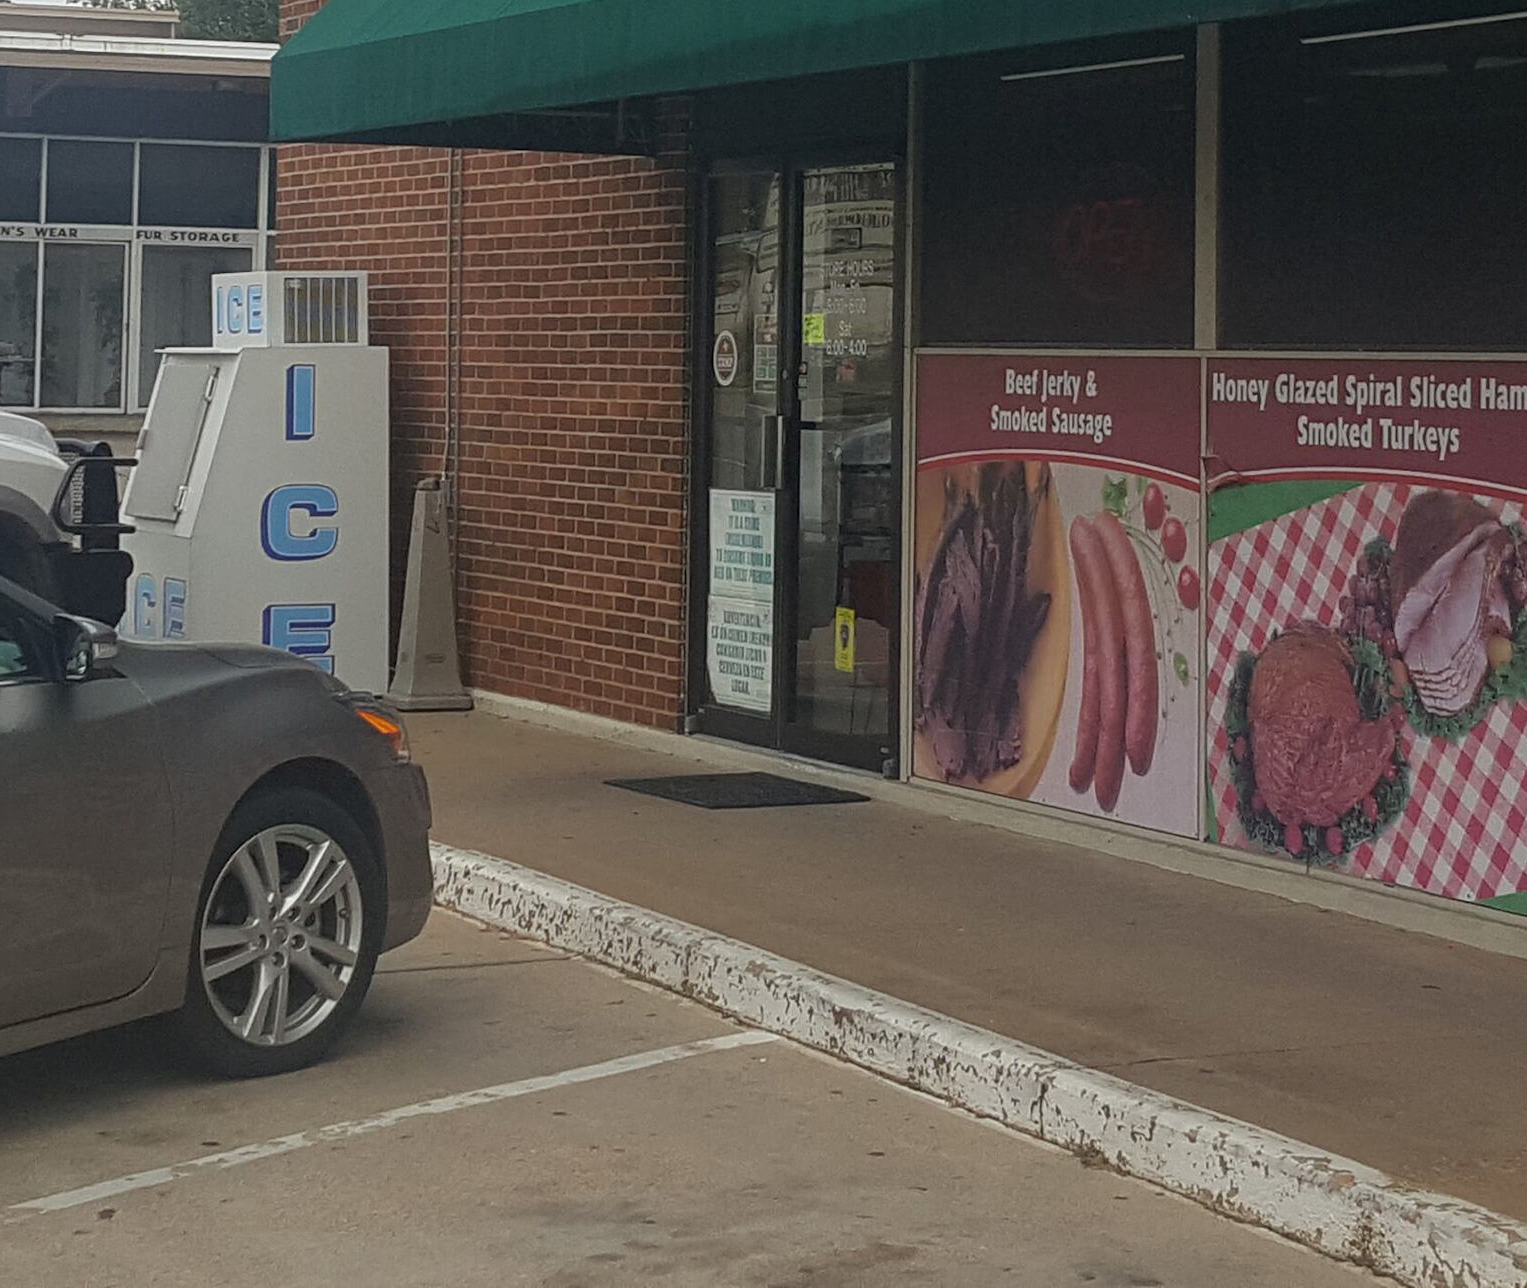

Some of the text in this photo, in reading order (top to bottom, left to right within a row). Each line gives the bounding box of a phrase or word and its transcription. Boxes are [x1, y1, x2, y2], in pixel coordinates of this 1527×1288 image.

[35, 227, 78, 238] WEAR
[136, 230, 240, 243] FUR STORAGE
[217, 284, 263, 334] ICE
[1005, 369, 1098, 404] Beef Jerky &
[1212, 373, 1269, 411] Honey
[1274, 373, 1339, 406] Glazed
[1345, 374, 1403, 415] Spiral
[1409, 375, 1471, 409] Sliced
[990, 405, 1113, 444] Smoked Sausage
[1297, 416, 1460, 461] Smoked Turkeys
[260, 363, 339, 676] ICE
[120, 572, 189, 639] CE
